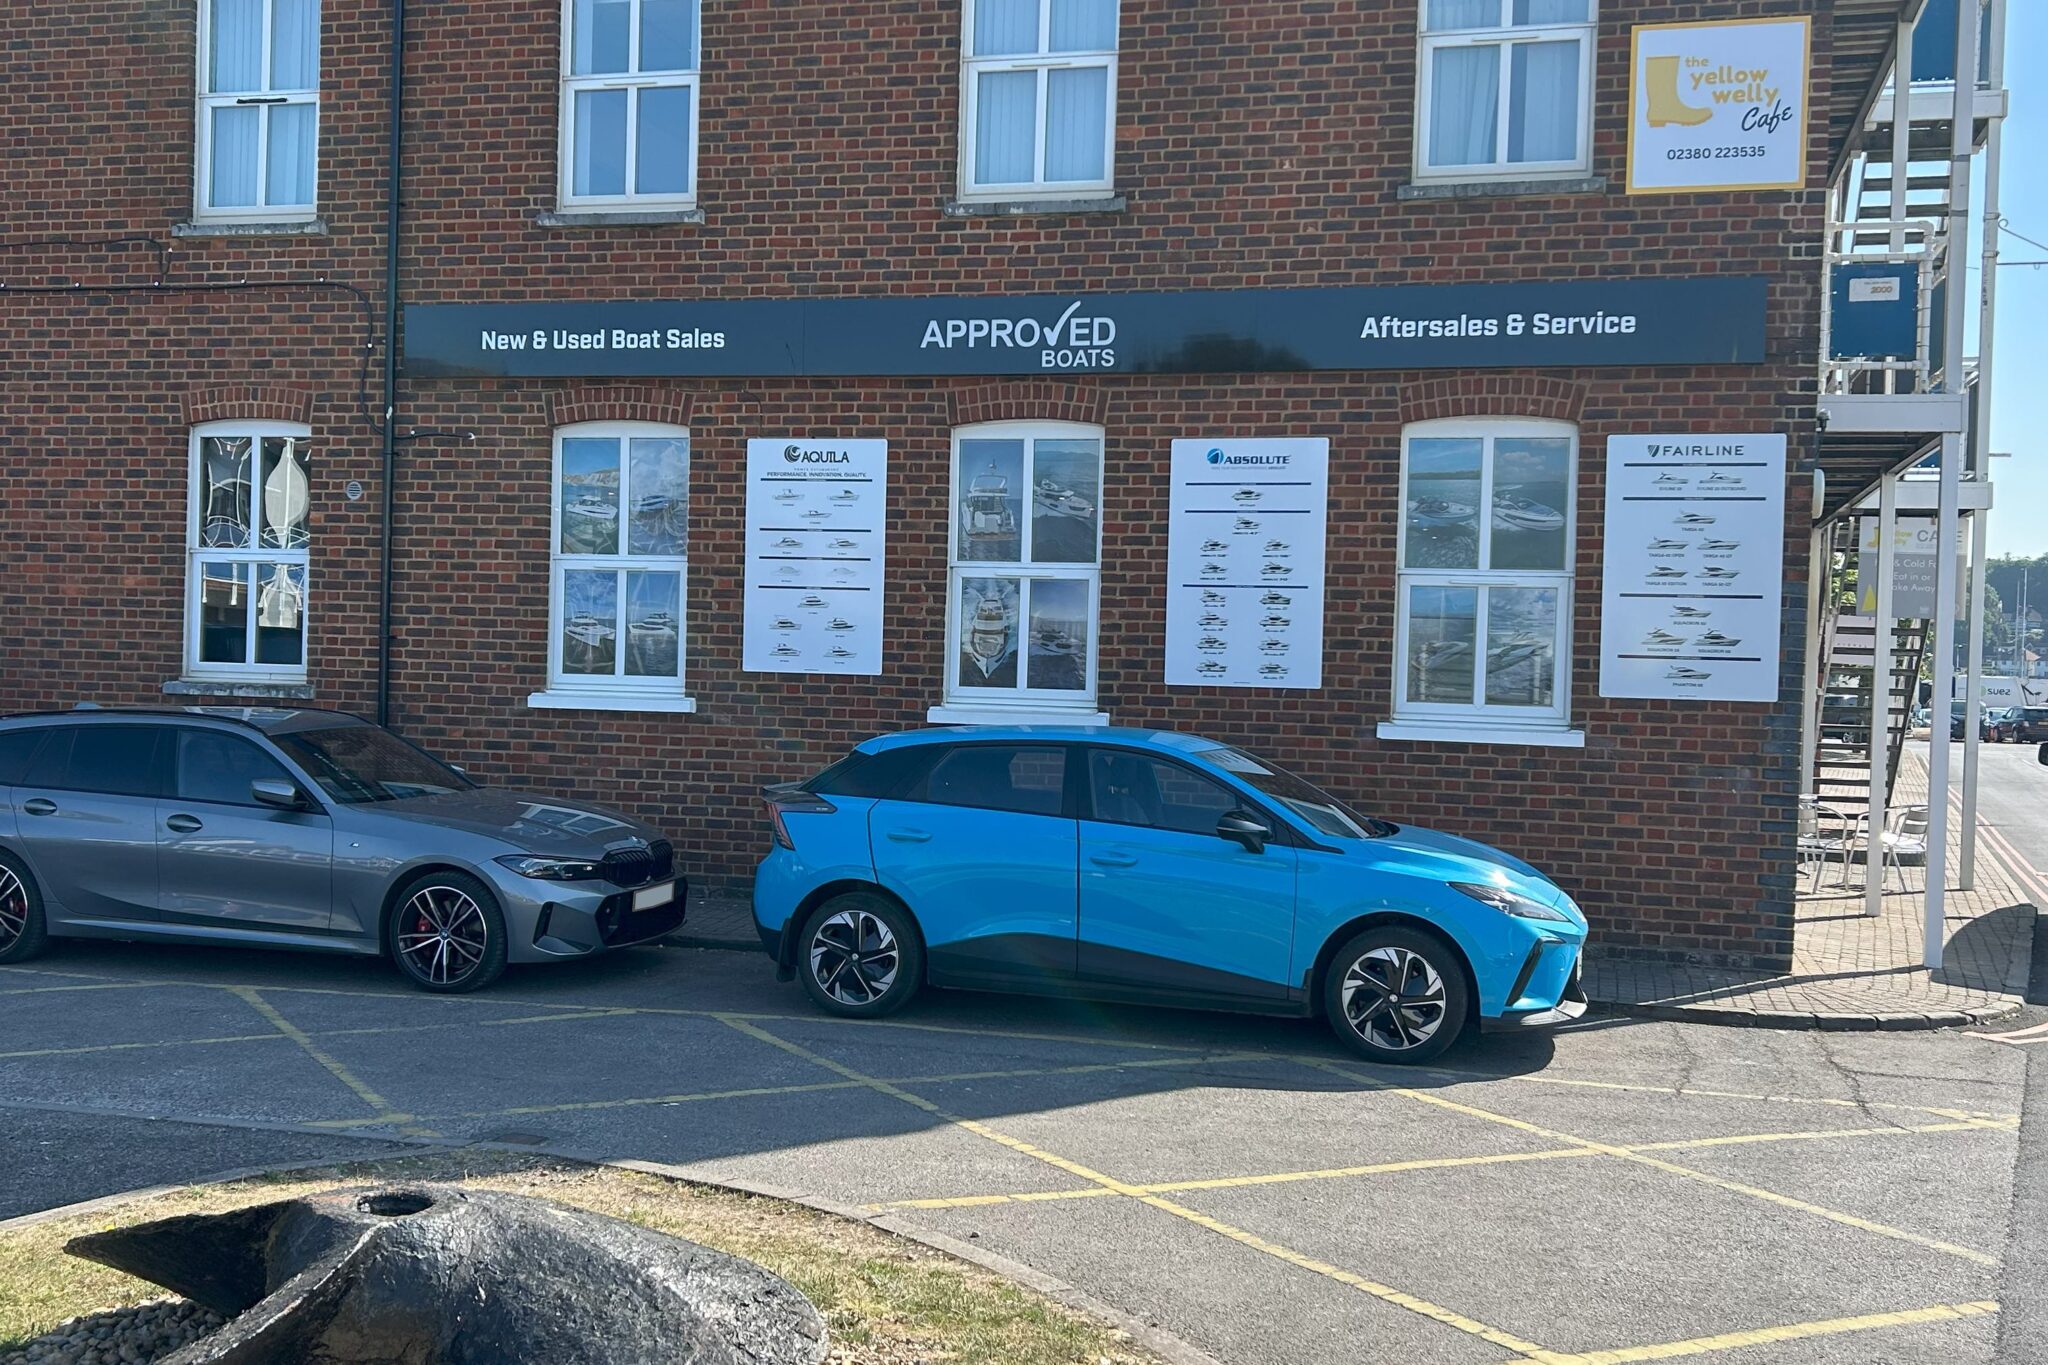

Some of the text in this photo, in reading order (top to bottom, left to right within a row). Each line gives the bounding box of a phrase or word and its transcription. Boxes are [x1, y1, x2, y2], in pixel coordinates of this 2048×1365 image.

[1685, 56, 1709, 67] the
[1690, 65, 1768, 91] yellow
[1712, 83, 1778, 107] welly
[1741, 98, 1793, 134] Cafe
[1667, 146, 1765, 160] 02380 223535
[1360, 311, 1637, 338] Aftersales & Service
[481, 328, 725, 349] New & Used Boat Sales
[1041, 349, 1115, 368] BOATS
[1662, 445, 1745, 456] FAIRLINE
[801, 451, 850, 463] AQUILA
[1224, 455, 1292, 465] ABSOLUTE
[1903, 558, 1926, 569] Cold
[1893, 572, 1908, 581] Eat
[1910, 573, 1919, 581] in
[1891, 583, 1937, 595] ake Away
[1987, 688, 2011, 696] suez
